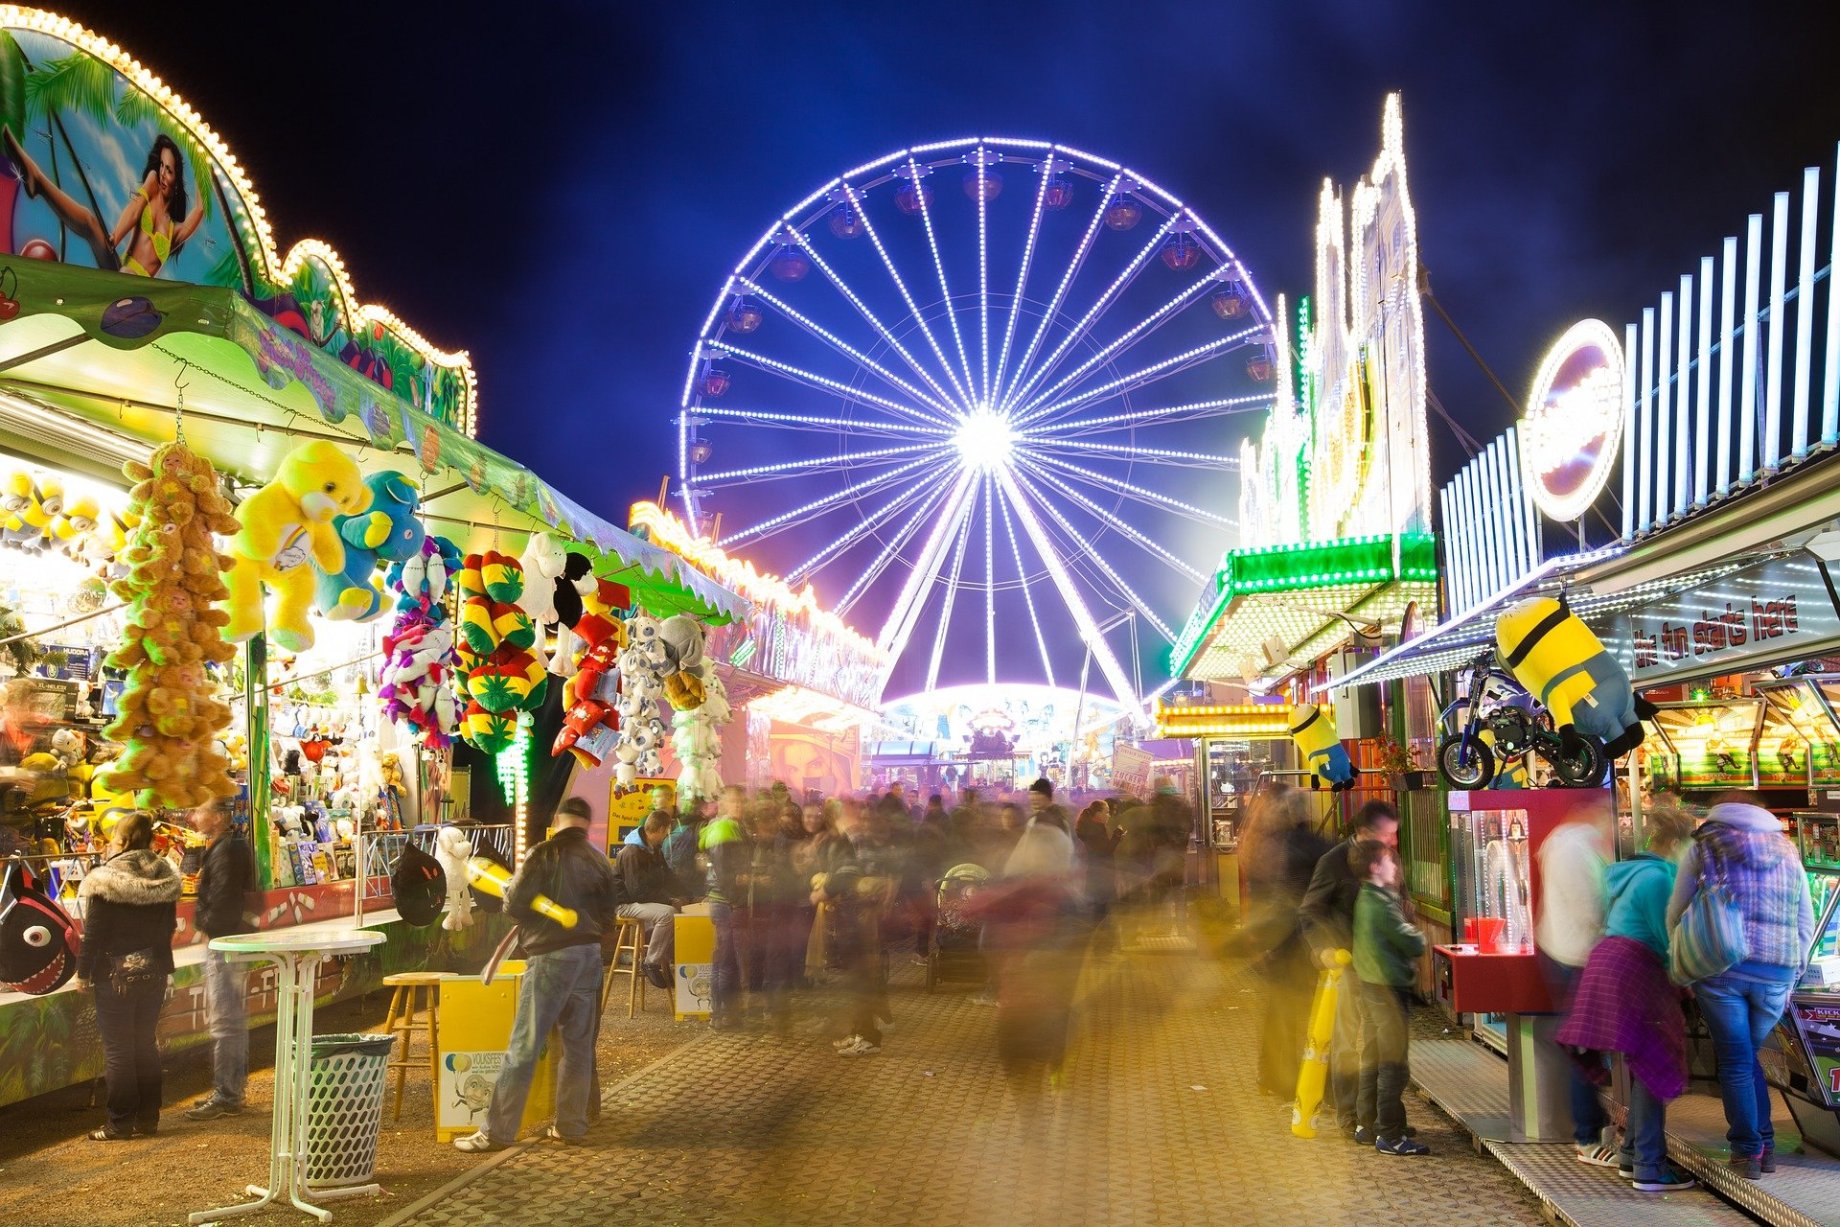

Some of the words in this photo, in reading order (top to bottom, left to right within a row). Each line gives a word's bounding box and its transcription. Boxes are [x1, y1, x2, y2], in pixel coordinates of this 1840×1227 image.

[1634, 629, 1659, 668] the
[1661, 622, 1689, 661] fun
[1693, 603, 1747, 655] starts
[1752, 594, 1799, 642] here
